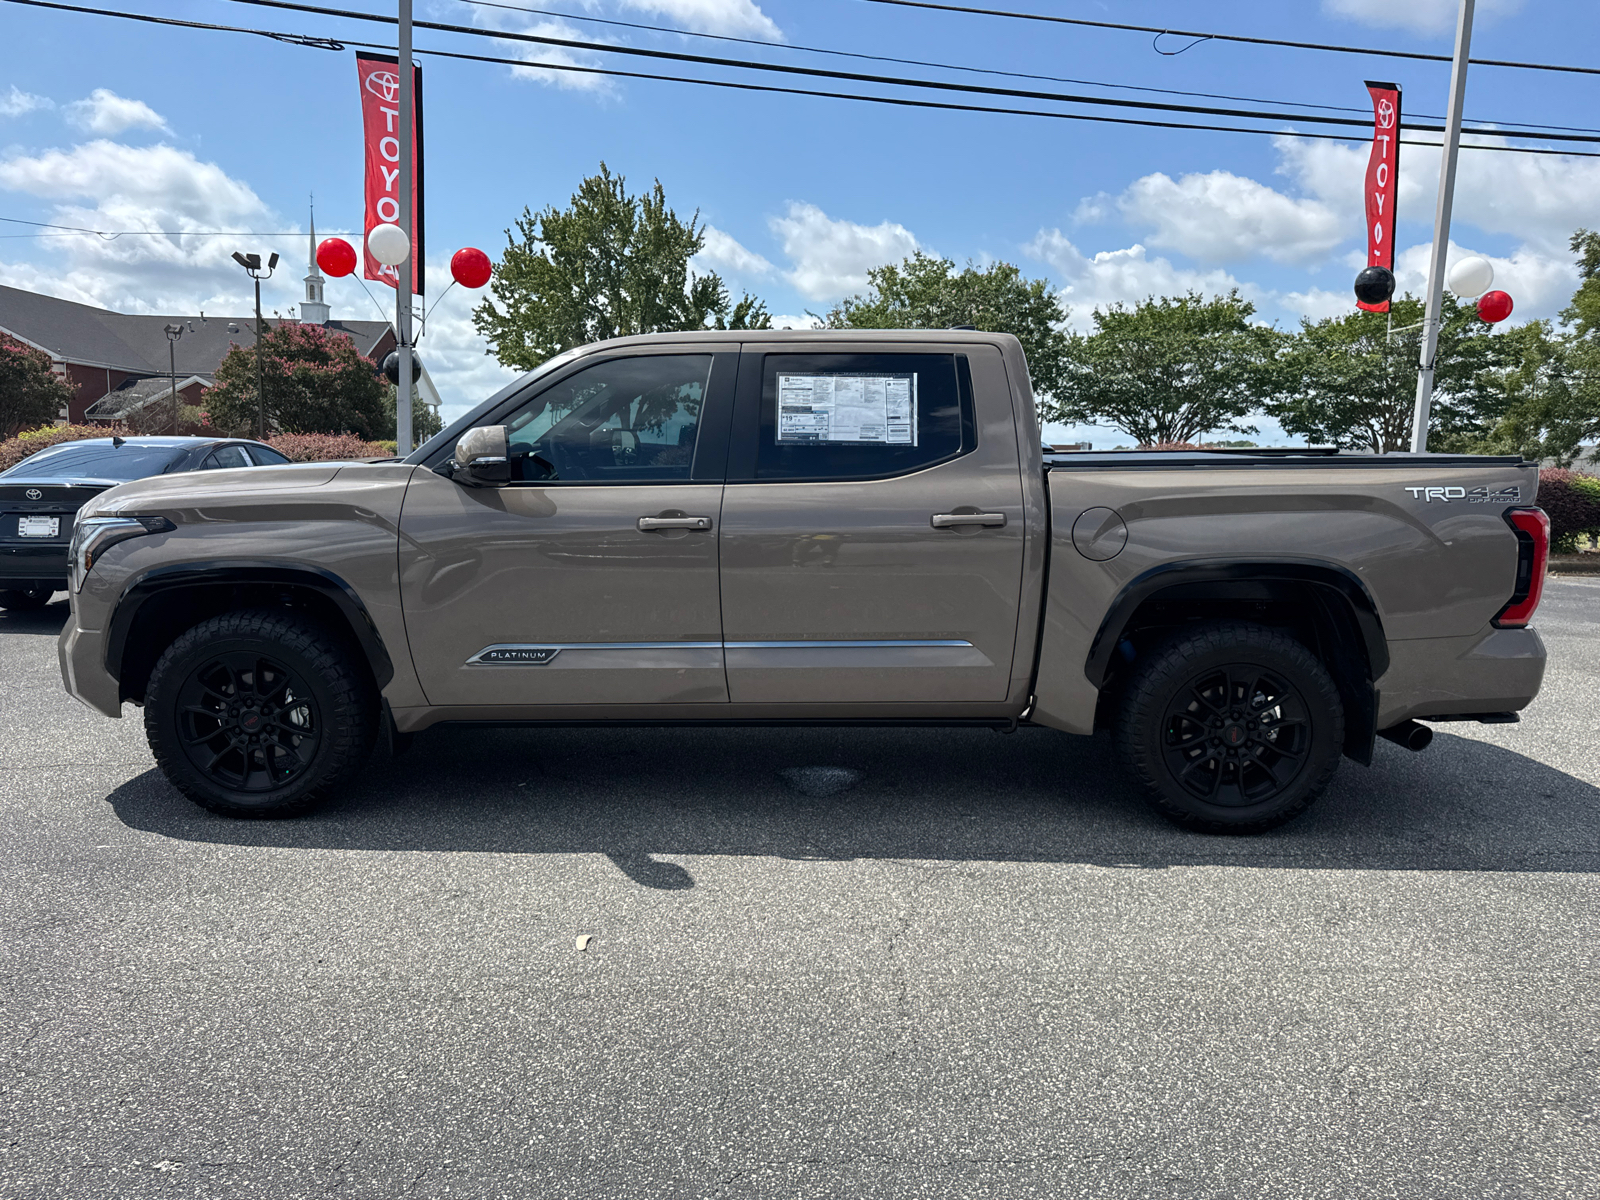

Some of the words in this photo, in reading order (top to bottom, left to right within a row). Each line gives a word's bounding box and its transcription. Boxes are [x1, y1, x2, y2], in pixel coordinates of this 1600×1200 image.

[376, 106, 400, 281] TOYOA
[1404, 486, 1466, 503] TRD
[1467, 486, 1521, 499] 4x4
[244, 715, 259, 727] TRD
